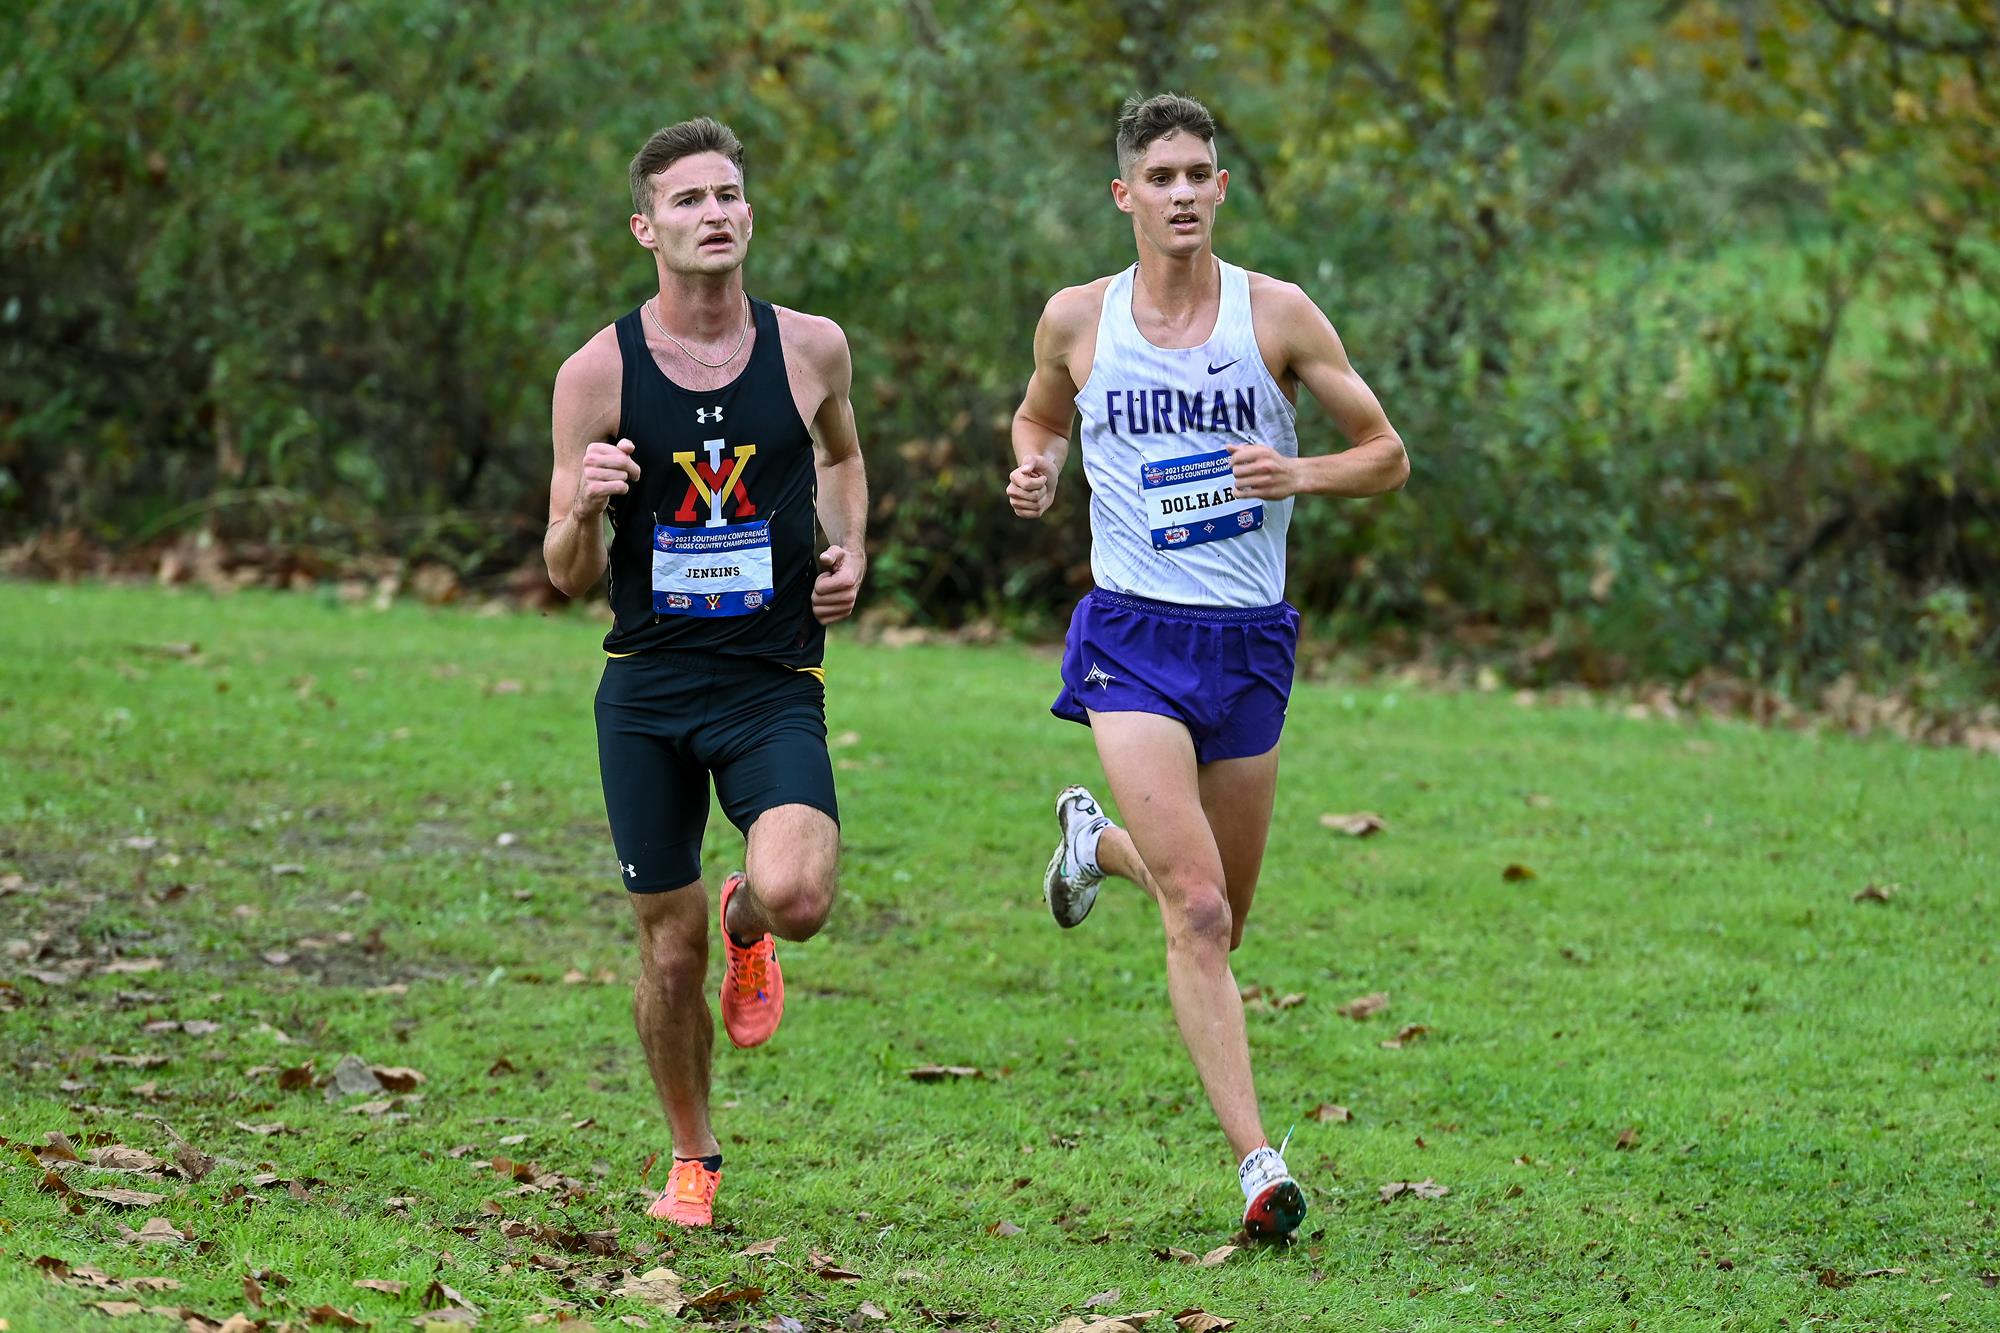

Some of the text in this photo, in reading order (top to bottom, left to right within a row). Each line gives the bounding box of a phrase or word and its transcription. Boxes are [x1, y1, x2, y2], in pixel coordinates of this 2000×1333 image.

[1106, 386, 1257, 435] FURMAN
[1164, 467, 1180, 475] 2021
[1181, 461, 1215, 472] SOUTHERN
[1165, 474, 1184, 482] CROSS
[1184, 468, 1212, 479] COUNTRY
[1161, 487, 1239, 515] DOLHAR
[728, 528, 768, 540] CONFERENCE
[675, 536, 769, 550] CROSS COUNTRY CHAMPIONSHIPS
[685, 566, 740, 579] JENKINS
